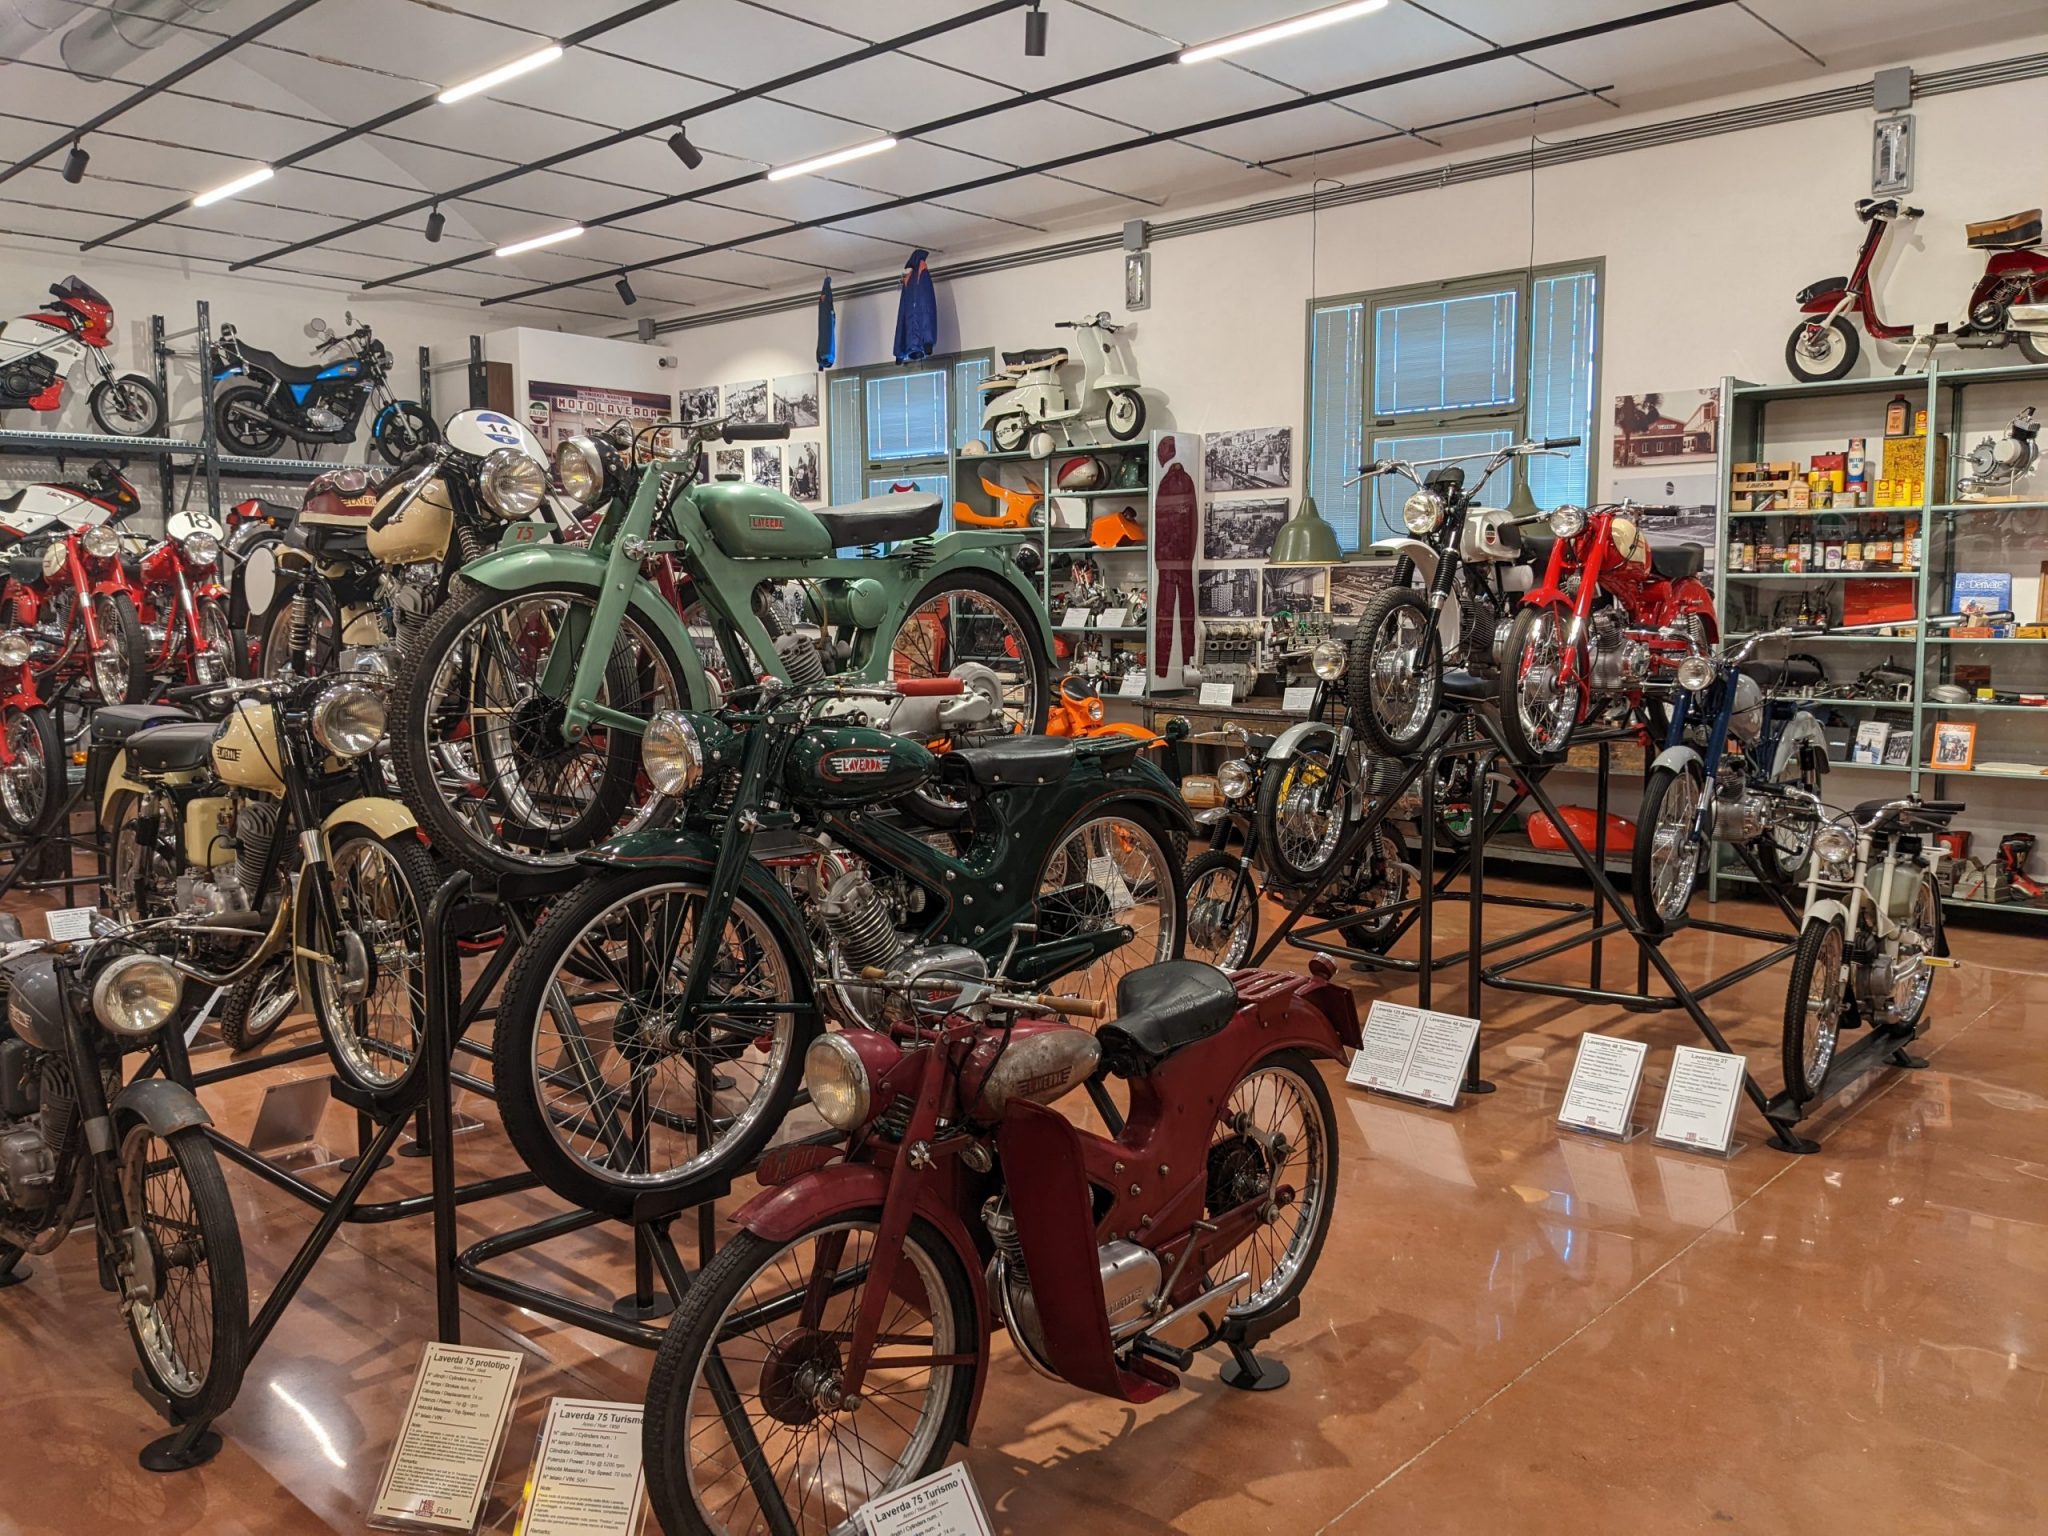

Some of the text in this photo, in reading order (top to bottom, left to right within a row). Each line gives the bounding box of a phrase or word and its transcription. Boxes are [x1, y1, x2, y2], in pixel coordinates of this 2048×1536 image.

[488, 424, 512, 434] 14
[184, 512, 212, 529] 18
[516, 526, 534, 540] 75
[842, 758, 882, 772] LAVERDA
[434, 1353, 510, 1370] Laverda 75 prototipo
[560, 1410, 595, 1420] Laverda
[597, 1413, 608, 1421] 75
[875, 1480, 958, 1523] Laverda 75 Turismo
